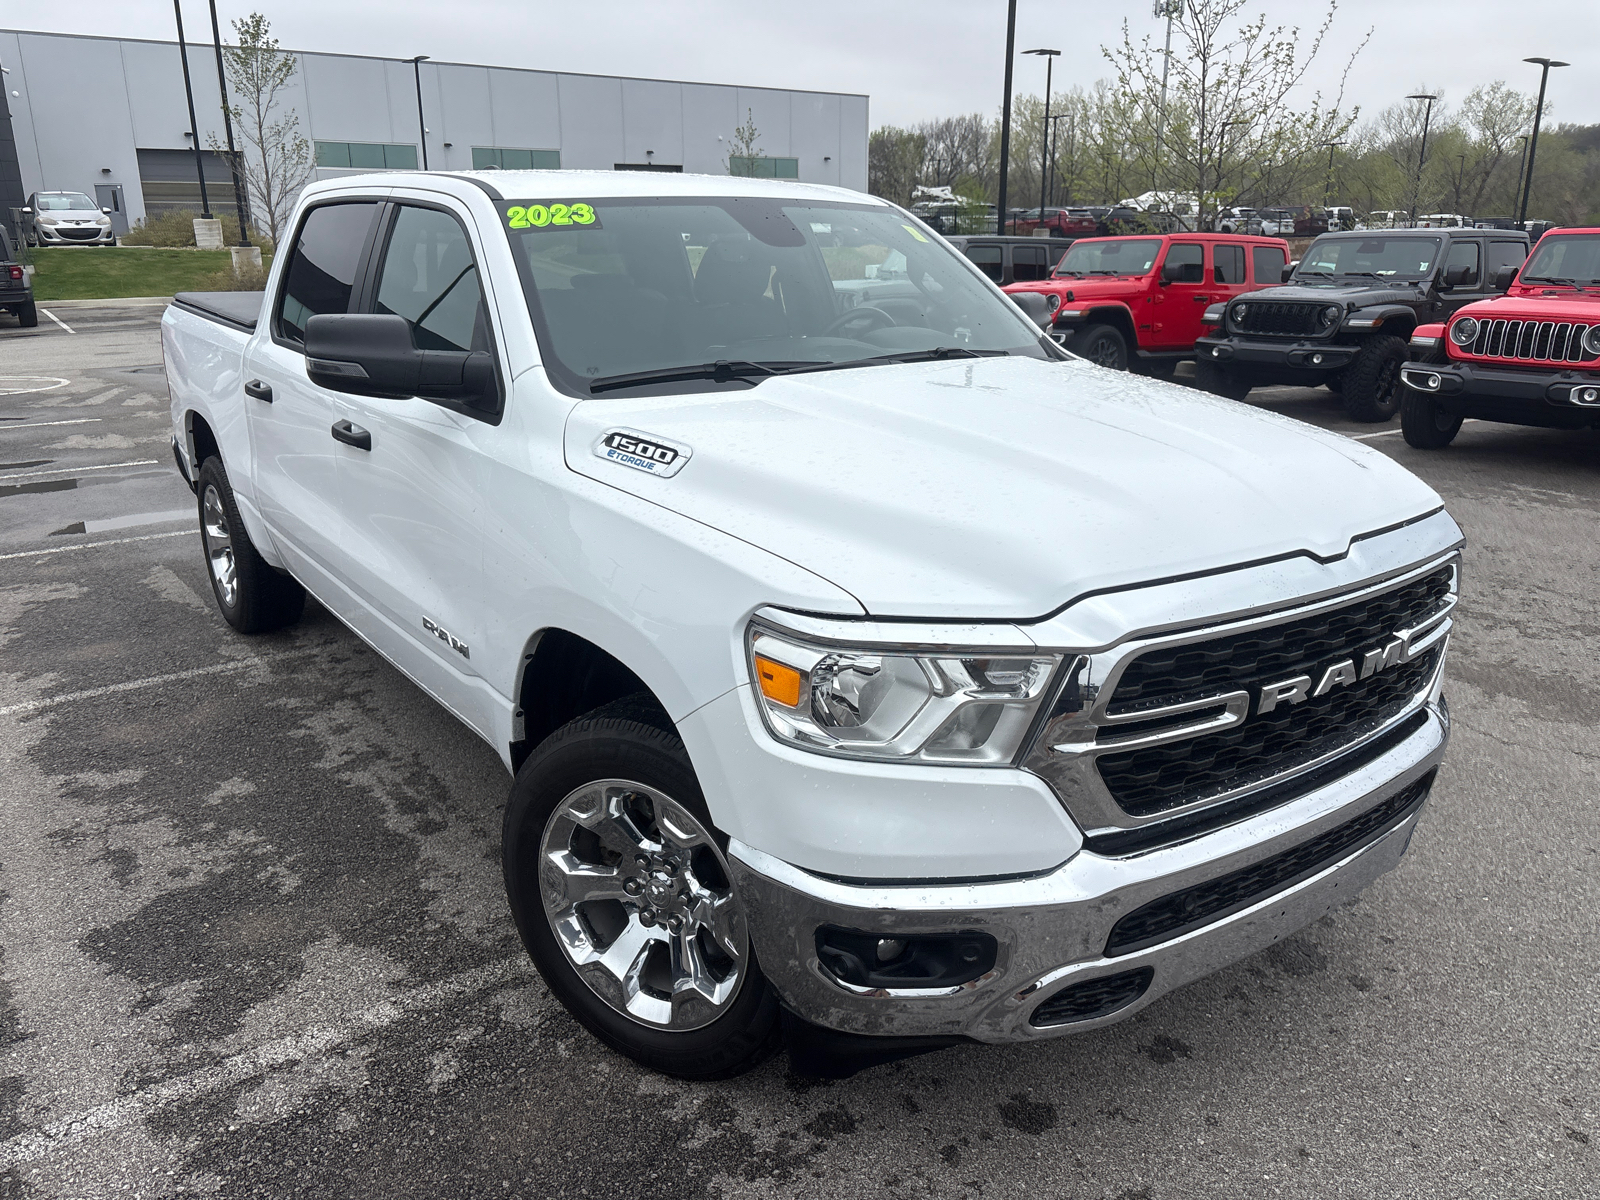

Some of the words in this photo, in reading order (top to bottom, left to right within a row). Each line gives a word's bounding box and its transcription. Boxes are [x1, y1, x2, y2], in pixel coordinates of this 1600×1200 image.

[507, 203, 596, 229] 2023
[611, 435, 675, 464] 1500
[422, 614, 470, 660] RAM
[1257, 638, 1403, 716] RAM
